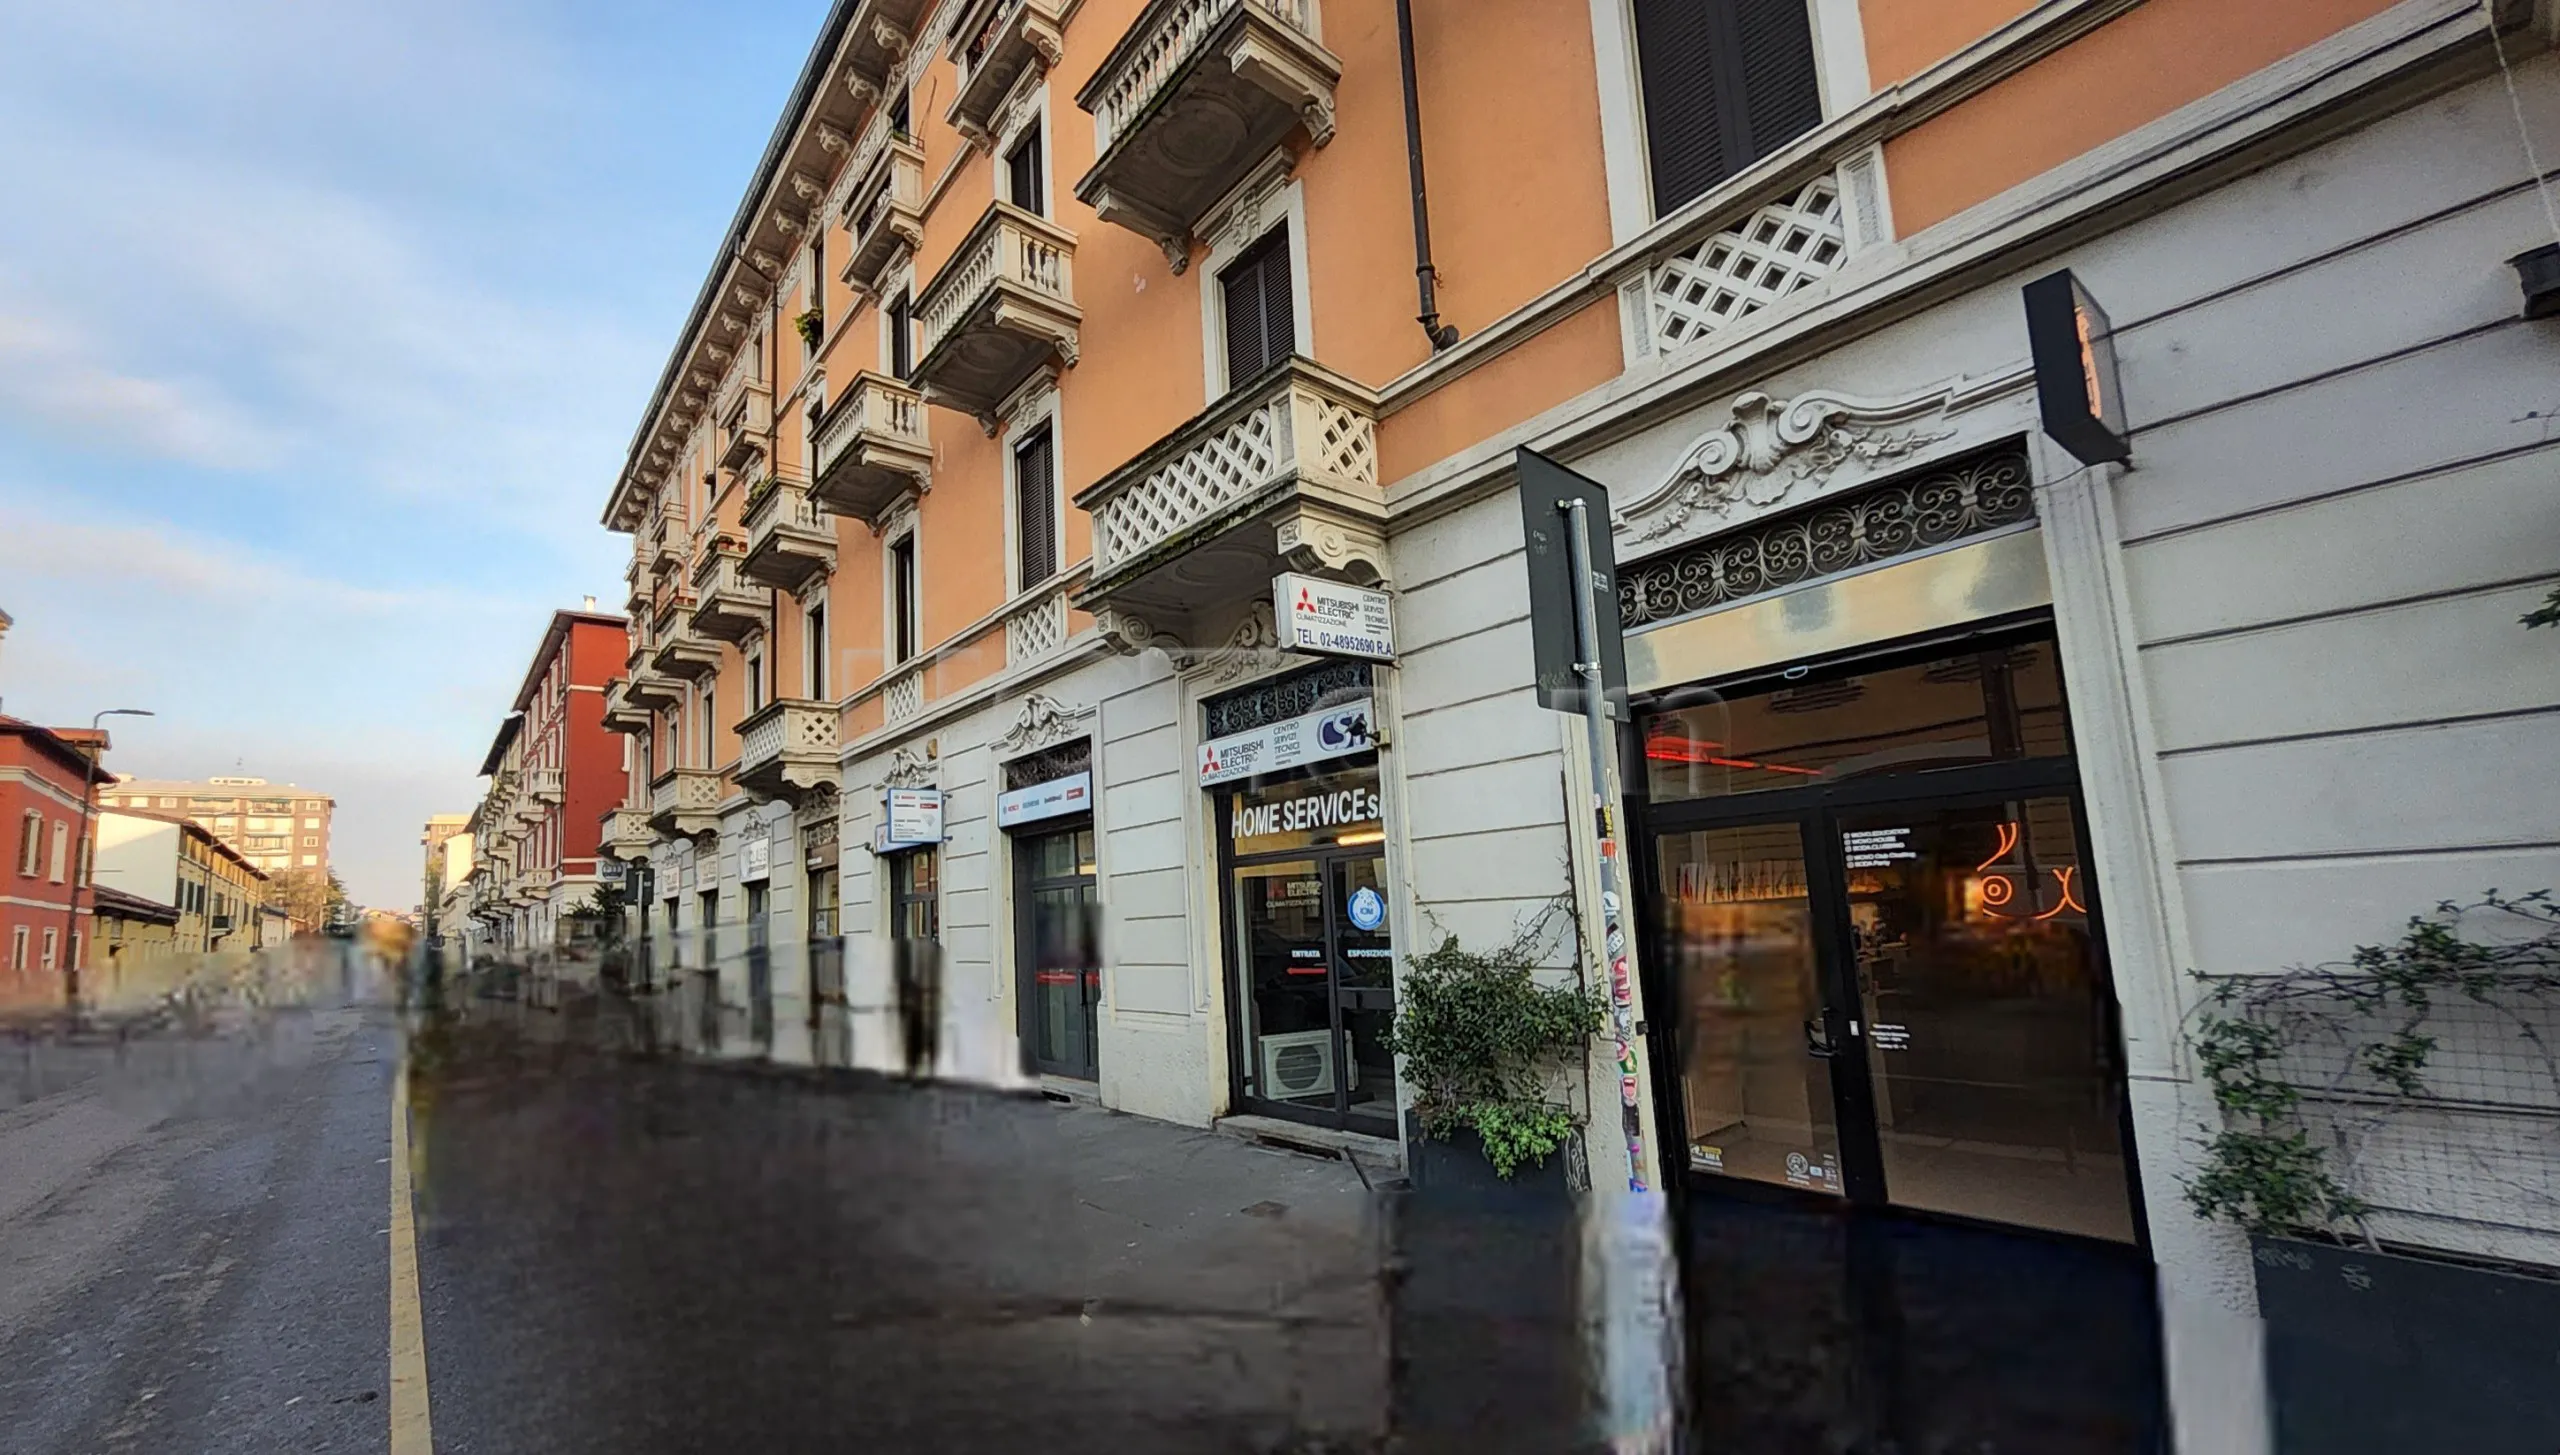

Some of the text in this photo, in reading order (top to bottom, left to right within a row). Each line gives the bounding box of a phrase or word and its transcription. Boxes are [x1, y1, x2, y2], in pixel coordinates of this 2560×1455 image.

[1317, 596, 1360, 612] MITSUBISHI
[1363, 594, 1387, 605] CENTRO
[1296, 612, 1347, 628] CLIMATIZZAZIONE
[1318, 605, 1355, 620] ELECTRIC
[1297, 628, 1318, 645] TEL.
[1320, 631, 1375, 653] 02-48952690
[1273, 721, 1299, 735] CENTRO
[1274, 732, 1297, 745] SERVIZI
[1220, 739, 1264, 759] MITSUBISHI
[1275, 742, 1300, 754] TECNICI
[1220, 752, 1258, 770] ELECTRIC
[1201, 765, 1251, 782] CLIMATIZZAZIONE
[1231, 803, 1281, 839] HOME
[1282, 788, 1366, 832] SERVICE
[1291, 949, 1321, 958] ENTRATA
[1347, 949, 1392, 958] ESPOSIZION
